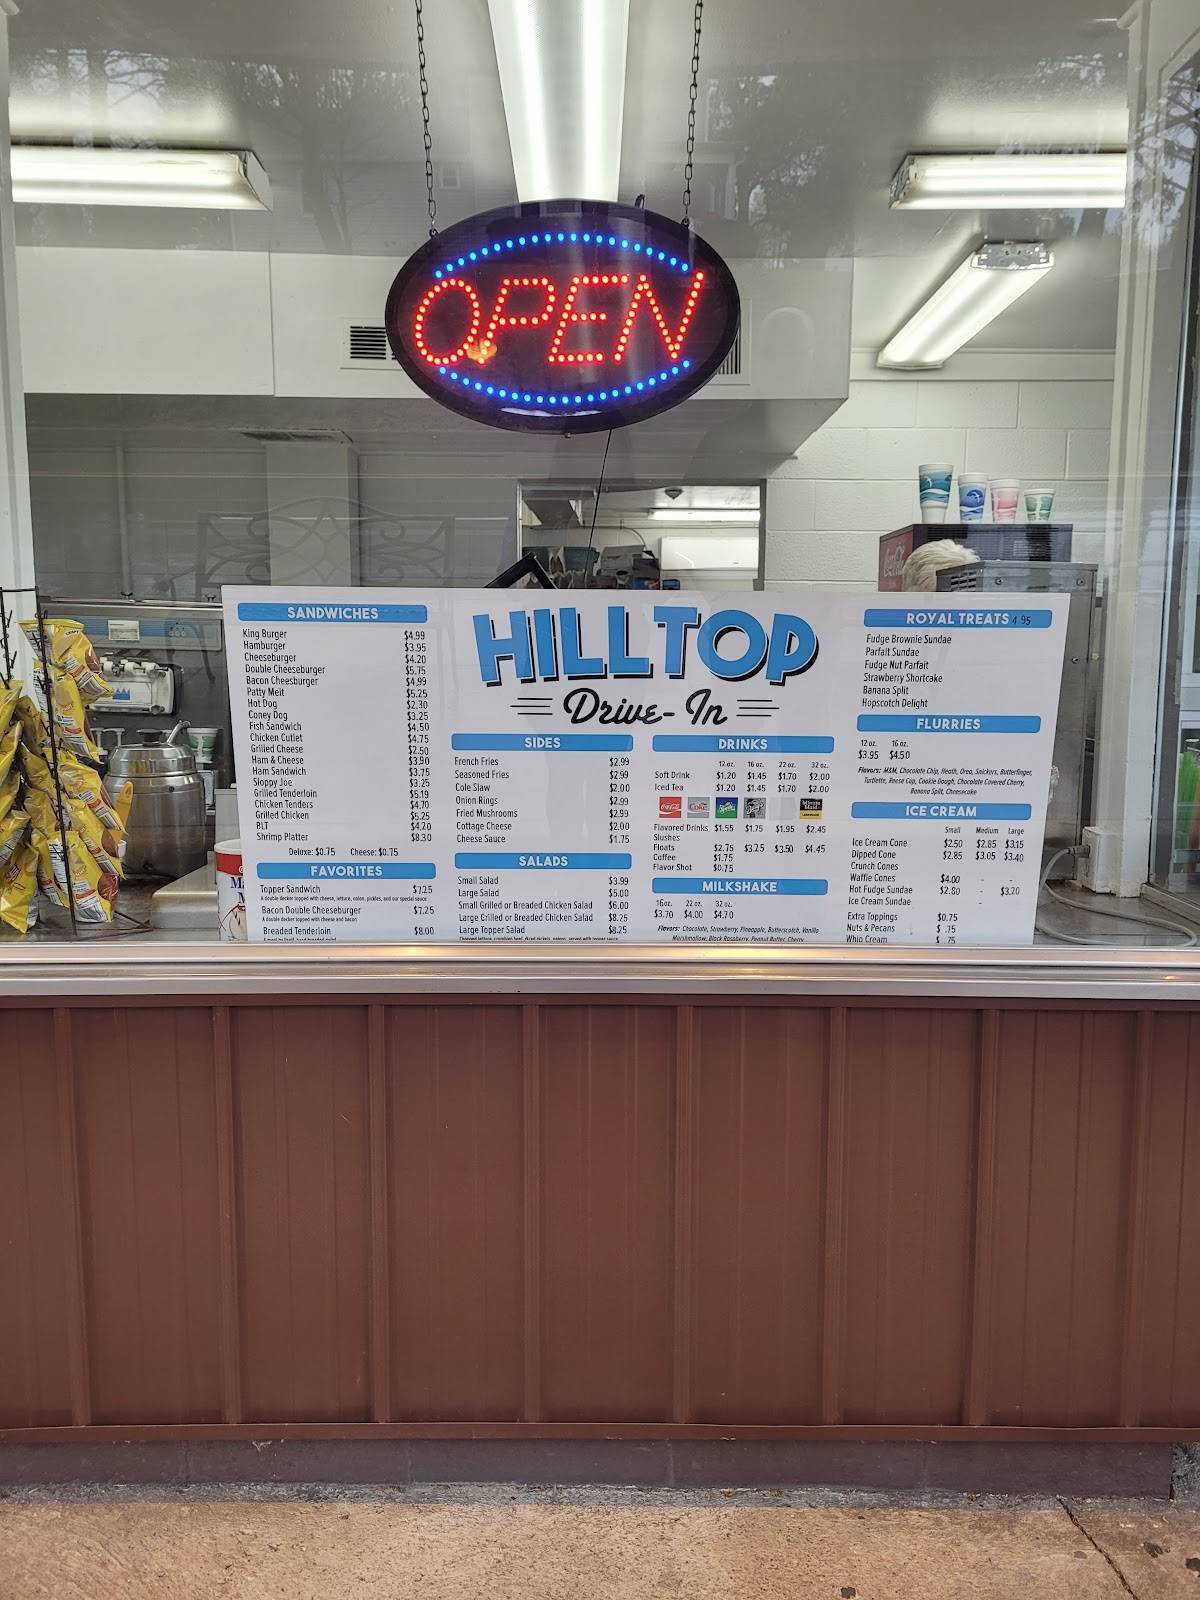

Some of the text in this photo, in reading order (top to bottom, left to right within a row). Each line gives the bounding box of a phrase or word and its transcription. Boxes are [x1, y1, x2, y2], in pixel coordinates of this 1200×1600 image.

[414, 271, 704, 366] OPEN
[288, 607, 378, 619] SANDWICHES
[907, 613, 954, 624] ROYAL
[959, 613, 1009, 624] TREATS
[243, 629, 425, 640] King Burger $4.99
[866, 634, 951, 645] Fudge Brownie Sundae
[243, 641, 426, 652] Hamburger $3.95
[473, 606, 819, 687] HILLTOP
[244, 653, 426, 664] Cheeseburger $4.20
[245, 665, 426, 675] Double Cheeseburger $5.75
[246, 676, 426, 687] Bacon Cheesburger $4.99
[864, 673, 942, 684] Strawberry Shortcake
[247, 688, 427, 698] Patty Melt $5.25
[863, 686, 909, 696] Banana Split
[248, 699, 428, 709] Hot Dog $2.30
[917, 719, 981, 729] FLURRIES
[250, 733, 429, 743] Chicken Cutlet $4.75
[525, 738, 560, 748] SIDES
[719, 738, 768, 750] DRINKS
[858, 751, 910, 760] $3.95 $4.50
[455, 757, 629, 767] French Fries $2.99
[455, 770, 628, 779] Seasoned Fries $2.99
[717, 772, 736, 780] $1.20
[747, 772, 766, 780] $1.45
[779, 772, 796, 781] $1.70
[810, 773, 830, 781] $2.00
[716, 784, 735, 792] $1.20
[747, 784, 766, 792] $1.45
[809, 785, 829, 793] $2.00
[456, 796, 628, 806] Onion Rings $2.99
[457, 809, 628, 818] Fried Mushrooms $2.99
[906, 806, 977, 816] ICE CREAM
[256, 822, 431, 831] BLT $4.20
[654, 824, 684, 832] Flavored
[745, 825, 763, 833] $1.75
[776, 825, 794, 833] $1.95
[806, 825, 826, 833] $2.45
[257, 833, 432, 842] Shrimp Platter $8.30
[457, 835, 629, 843] Cheese Sauce $1.75
[853, 838, 863, 846] Ice
[890, 839, 907, 847] Cone
[944, 840, 963, 848] $2.50
[977, 840, 996, 848] $2.85
[1005, 840, 1024, 849] $3.15
[289, 848, 398, 857] Deluxe: $0.75 Cheese: $0.75
[519, 856, 568, 866] SALADS
[714, 854, 733, 862] $1.75
[311, 866, 383, 876] FAVORITES
[458, 876, 628, 885] Small Salad $3.99
[260, 885, 432, 894] Topper Sandwich $7.25
[702, 881, 777, 892] MILKSHAKE
[850, 886, 1019, 895] Hot Fudge Sundae $2.80 $3.20
[459, 901, 477, 909] Small
[480, 901, 502, 909] Grilled
[514, 901, 542, 909] Breaded
[545, 901, 571, 909] Chicken
[573, 901, 592, 909] Salad
[609, 902, 628, 910] $6.00
[262, 906, 434, 916] Bacon Double Cheeseburger $7.25
[654, 909, 733, 919] $3.70 $4.00 $4.70
